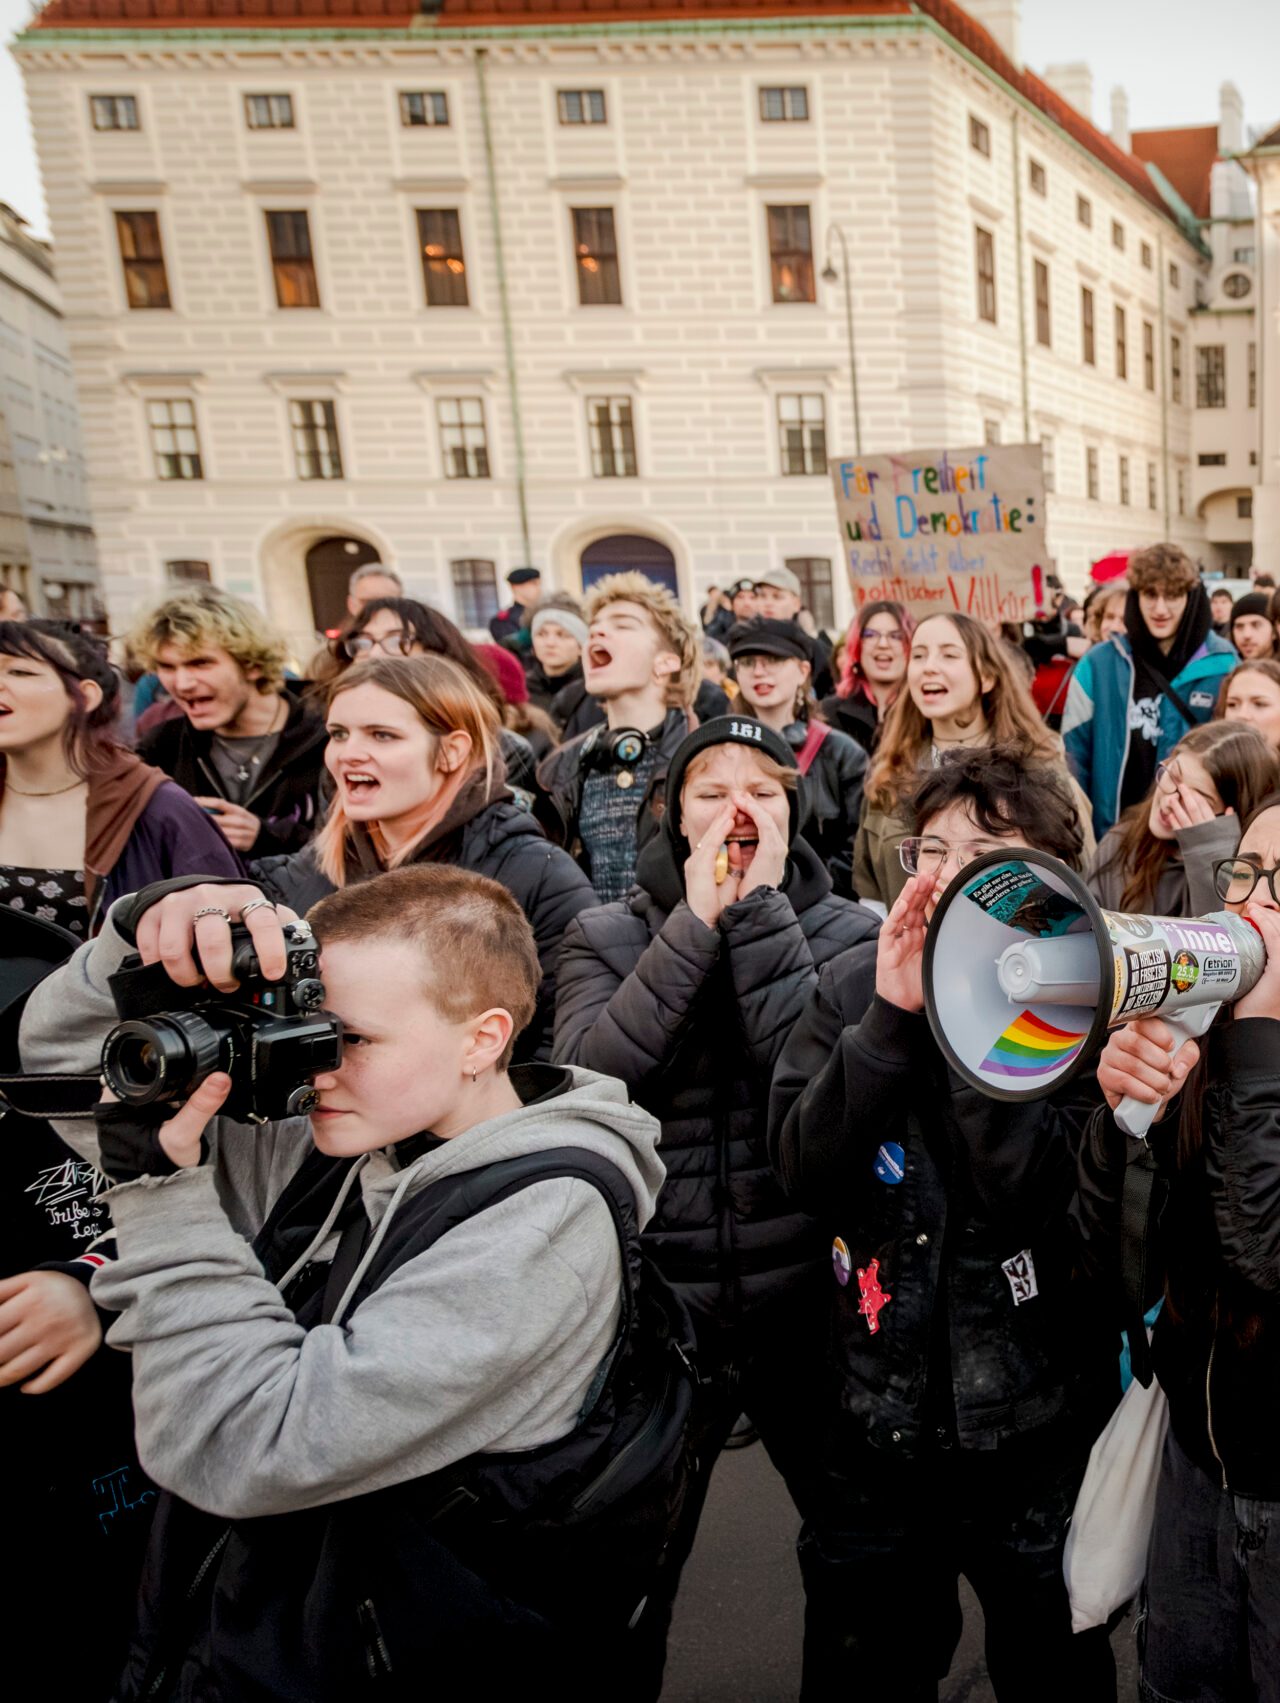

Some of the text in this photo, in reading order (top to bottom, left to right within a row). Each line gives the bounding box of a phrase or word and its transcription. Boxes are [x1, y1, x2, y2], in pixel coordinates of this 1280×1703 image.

[840, 461, 879, 499] Für
[1139, 948, 1168, 969] RACISM
[1140, 963, 1168, 984] FASCISM
[45, 1200, 90, 1225] Tribe
